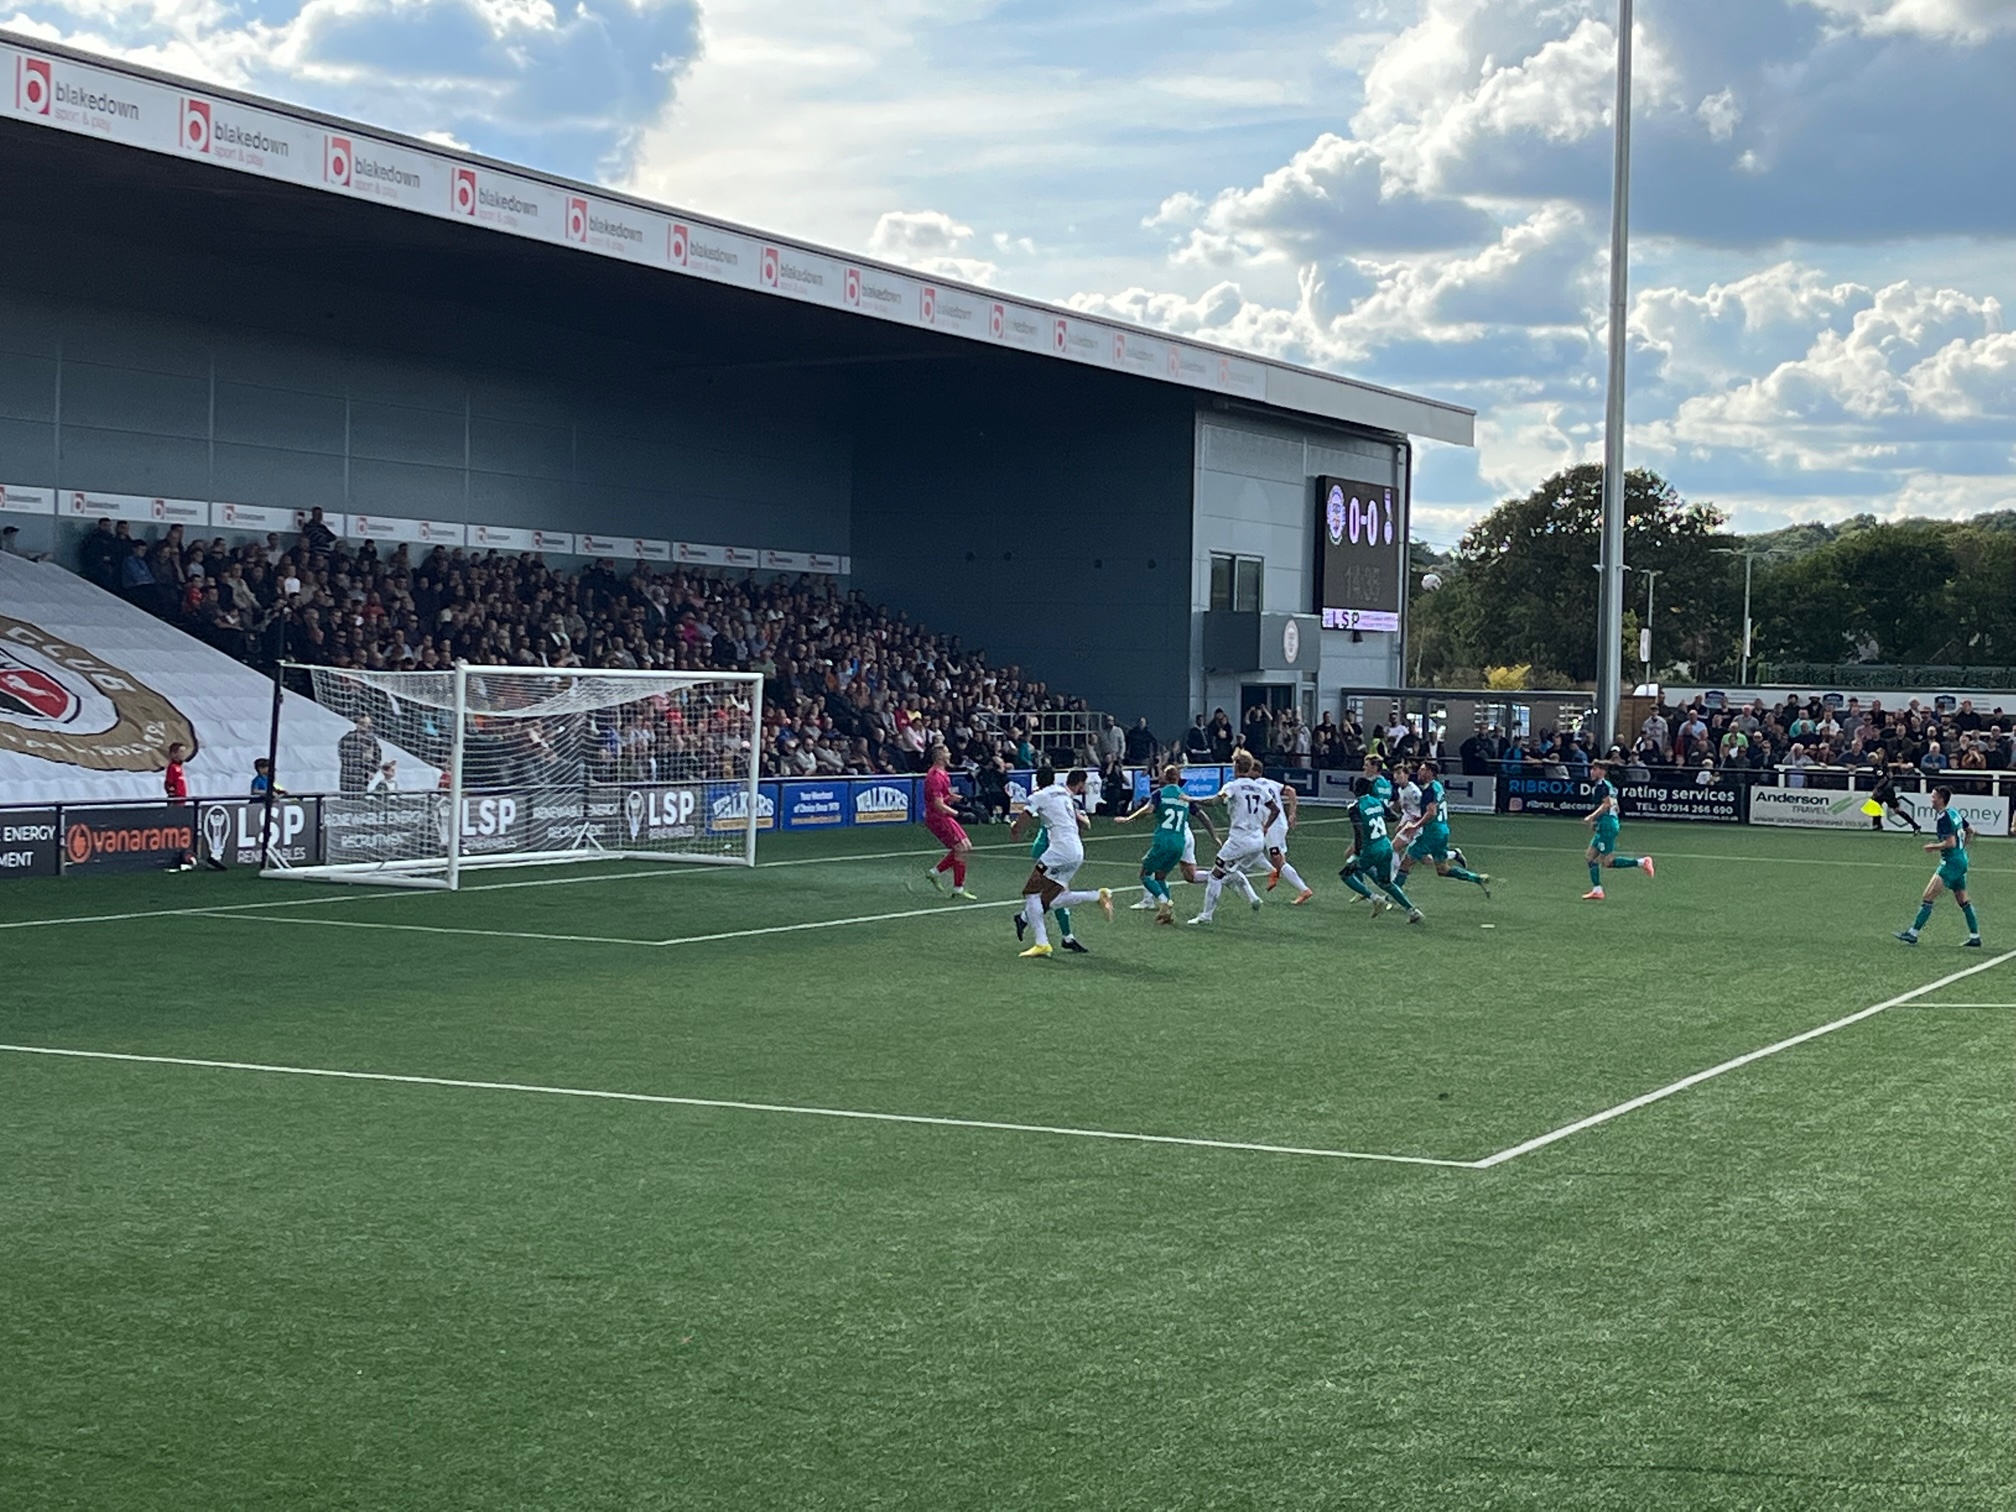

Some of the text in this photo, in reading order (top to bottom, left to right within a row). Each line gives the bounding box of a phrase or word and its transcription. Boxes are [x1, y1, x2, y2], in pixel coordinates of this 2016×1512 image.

[55, 81, 140, 120] blakedown
[214, 120, 289, 157] blakedown
[354, 156, 421, 189] blakedown
[478, 187, 538, 216] blakedown
[1332, 610, 1360, 629] LSP
[855, 786, 909, 812] WALKERS
[1244, 794, 1261, 815] 17
[1508, 780, 1575, 795] RIBROX
[1671, 787, 1736, 802] services
[1755, 791, 1829, 805] Anderson
[461, 799, 516, 836] LSP
[648, 791, 695, 826] LSP
[712, 791, 774, 820] WALKRS
[1791, 805, 1828, 816] TRAVEL
[4, 825, 57, 842] ENERGY
[237, 804, 305, 849] LSP
[1161, 808, 1185, 832] 21
[93, 826, 192, 853] vanarama
